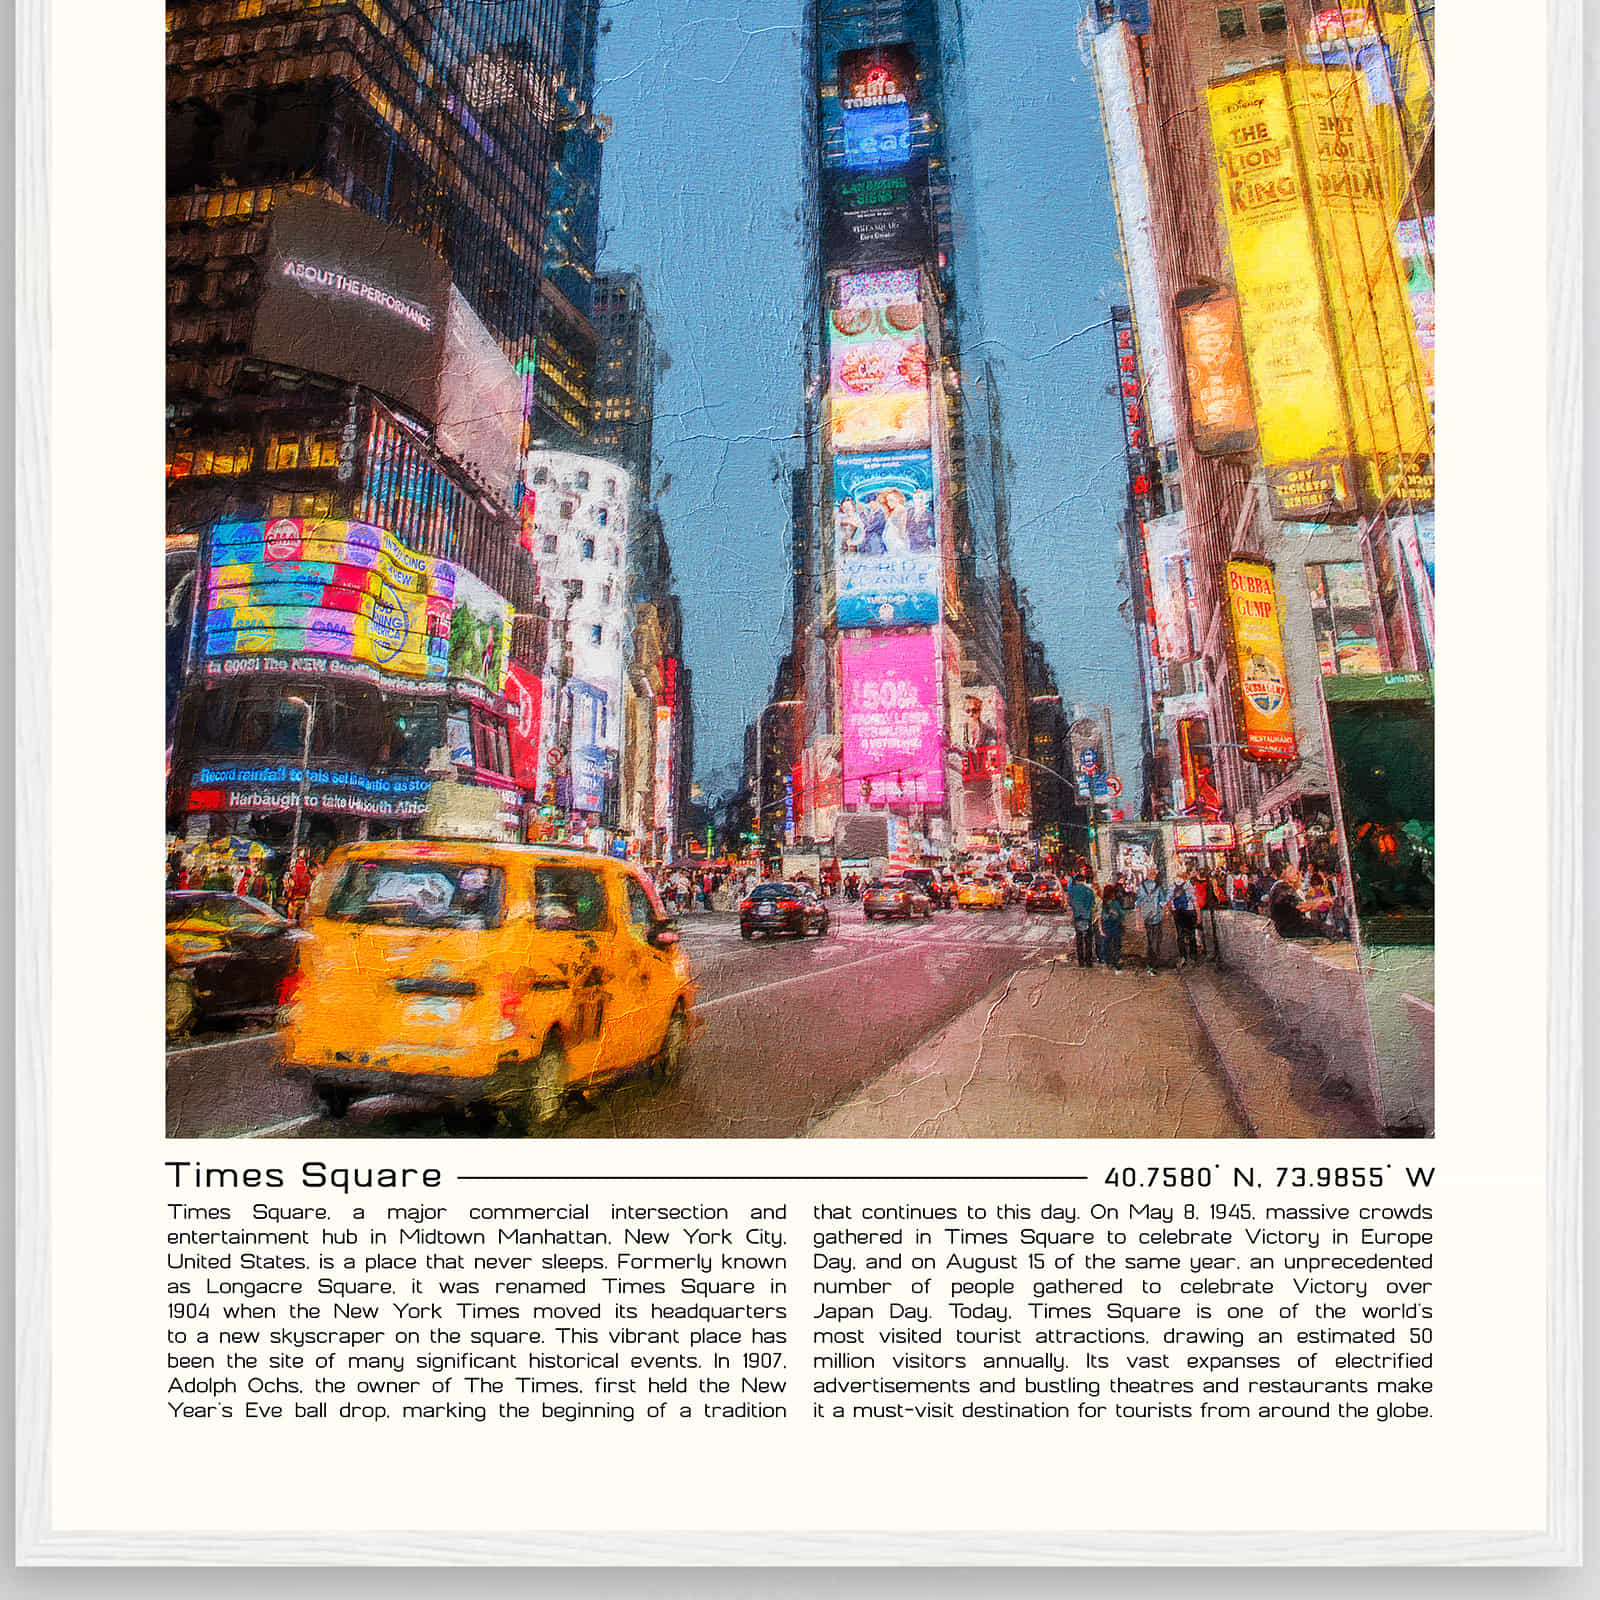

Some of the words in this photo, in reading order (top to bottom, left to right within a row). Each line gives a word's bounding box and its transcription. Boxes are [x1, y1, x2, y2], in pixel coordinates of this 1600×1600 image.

[844, 93, 906, 109] TOSHIBA
[1229, 122, 1269, 145] THE
[1225, 146, 1281, 179] LION
[1228, 176, 1299, 216] KING
[283, 260, 335, 286] ABOUT
[336, 274, 360, 295] THE
[360, 283, 432, 331] PERFORMANCE
[1230, 570, 1272, 596] BUBBA
[1236, 595, 1273, 619] GUMP
[200, 767, 236, 783] Record
[238, 766, 287, 782] rainfall
[229, 791, 300, 810] Harbaugh
[304, 795, 319, 807] to
[164, 1161, 284, 1188] Times
[302, 1161, 441, 1195] Square
[1405, 1167, 1436, 1188] W
[167, 1203, 231, 1220] Times
[352, 1207, 365, 1220] a
[387, 1203, 448, 1224] major
[469, 1203, 589, 1220] commercial
[611, 1203, 729, 1220] intersection
[750, 1203, 787, 1220] and
[813, 1228, 903, 1249] gathered
[915, 1228, 932, 1245] in
[944, 1228, 1009, 1245] Times
[1020, 1228, 1095, 1249] Square
[1107, 1230, 1127, 1245] to
[1138, 1228, 1233, 1245] celebrate
[1244, 1228, 1320, 1249] Victory
[1332, 1228, 1349, 1245] in
[1361, 1228, 1433, 1249] Europe
[813, 1277, 893, 1295] number
[911, 1277, 933, 1294] of
[951, 1277, 1015, 1299] people
[1032, 1277, 1123, 1298] gathered
[1142, 1279, 1162, 1294] to
[1180, 1277, 1274, 1295] celebrate
[1292, 1277, 1367, 1299] Victory
[1386, 1281, 1433, 1295] over
[167, 1302, 210, 1319] 1904
[223, 1303, 276, 1319] when
[289, 1303, 321, 1319] the
[333, 1303, 379, 1319] New
[392, 1302, 443, 1319] York
[455, 1302, 520, 1319] Times
[533, 1302, 601, 1319] moved
[615, 1302, 638, 1319] its
[651, 1302, 787, 1323] headquarters
[813, 1302, 874, 1323] Japan
[889, 1302, 932, 1323] Day.
[1027, 1302, 1092, 1320] Times
[1106, 1302, 1181, 1323] Square
[1196, 1302, 1212, 1319] is
[1227, 1306, 1264, 1319] one
[1279, 1302, 1300, 1319] of
[1315, 1303, 1347, 1319] the
[167, 1328, 187, 1344] to
[196, 1331, 209, 1344] a
[219, 1331, 261, 1344] new
[270, 1327, 385, 1348] skyscraper
[395, 1331, 420, 1345] on
[430, 1327, 461, 1344] the
[470, 1331, 545, 1348] square.
[554, 1327, 599, 1345] This
[608, 1327, 680, 1344] vibrant
[690, 1327, 742, 1348] place
[751, 1327, 787, 1344] has
[813, 1329, 865, 1344] most
[879, 1327, 942, 1345] visited
[956, 1327, 1022, 1344] tourist
[1163, 1327, 1244, 1348] drawing
[1258, 1331, 1283, 1344] an
[1296, 1327, 1395, 1344] estimated
[1409, 1327, 1433, 1344] 50
[167, 1352, 215, 1369] been
[226, 1352, 258, 1369] the
[269, 1352, 304, 1369] site
[315, 1352, 337, 1369] of
[348, 1356, 405, 1373] many
[416, 1352, 517, 1373] significant
[529, 1352, 619, 1369] historical
[630, 1354, 702, 1369] events.
[714, 1351, 730, 1369] In
[813, 1352, 875, 1369] million
[892, 1352, 967, 1369] visitors
[983, 1352, 1069, 1373] annually.
[1086, 1352, 1110, 1369] Its
[1126, 1354, 1170, 1369] vast
[1186, 1356, 1281, 1373] expanses
[1297, 1352, 1318, 1369] of
[1335, 1351, 1433, 1369] electrified
[813, 1376, 971, 1394] advertisements
[979, 1377, 1016, 1394] and
[1025, 1376, 1100, 1398] bustling
[1110, 1377, 1194, 1394] theatres
[1202, 1376, 1239, 1394] and
[1248, 1378, 1369, 1394] restaurants
[1377, 1376, 1433, 1394] make
[813, 1401, 825, 1418] it
[832, 1405, 845, 1418] a
[852, 1401, 955, 1418] must-visit
[962, 1401, 1070, 1419] destination
[1077, 1401, 1108, 1418] for
[1115, 1401, 1193, 1418] tourists
[1199, 1401, 1251, 1418] from
[1258, 1401, 1330, 1418] around
[1338, 1401, 1369, 1418] the
[1376, 1401, 1433, 1423] globe.
